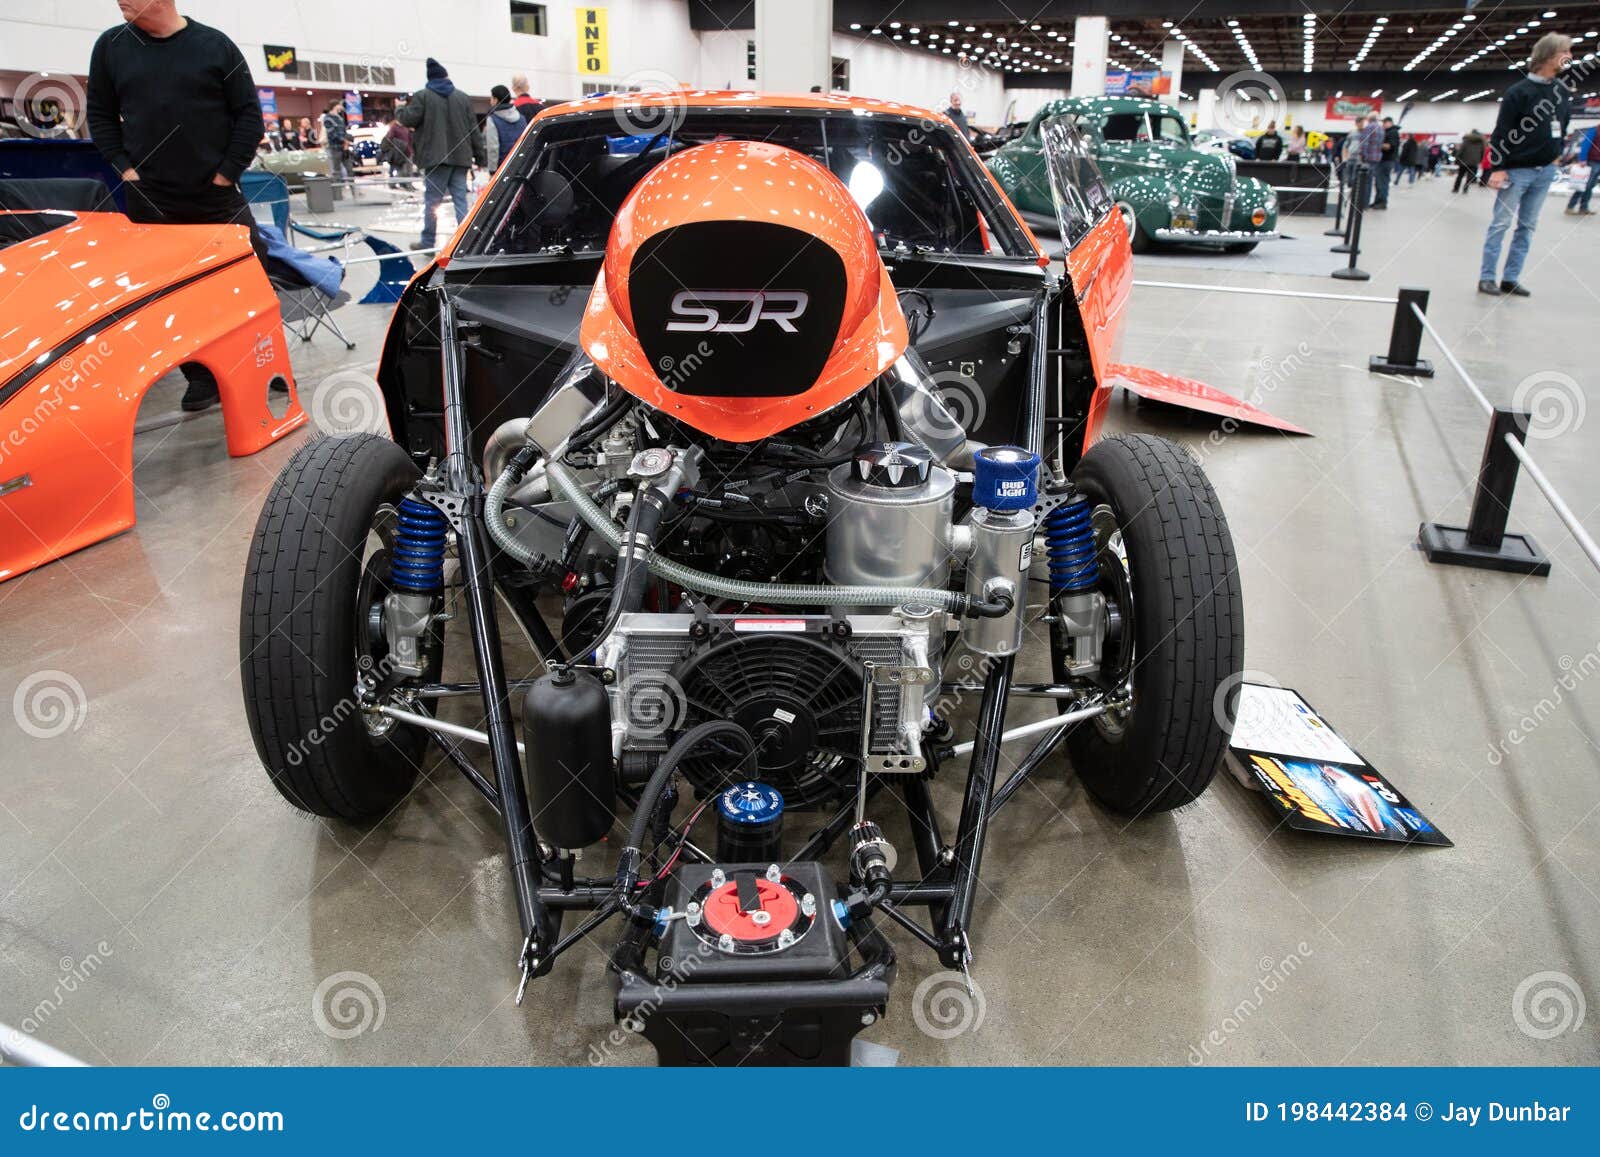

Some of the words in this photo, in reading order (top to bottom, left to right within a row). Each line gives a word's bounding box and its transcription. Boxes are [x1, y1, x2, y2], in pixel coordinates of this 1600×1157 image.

[585, 10, 601, 71] INFO
[1001, 481, 1025, 490] BUD
[996, 488, 1028, 497] LIGHT
